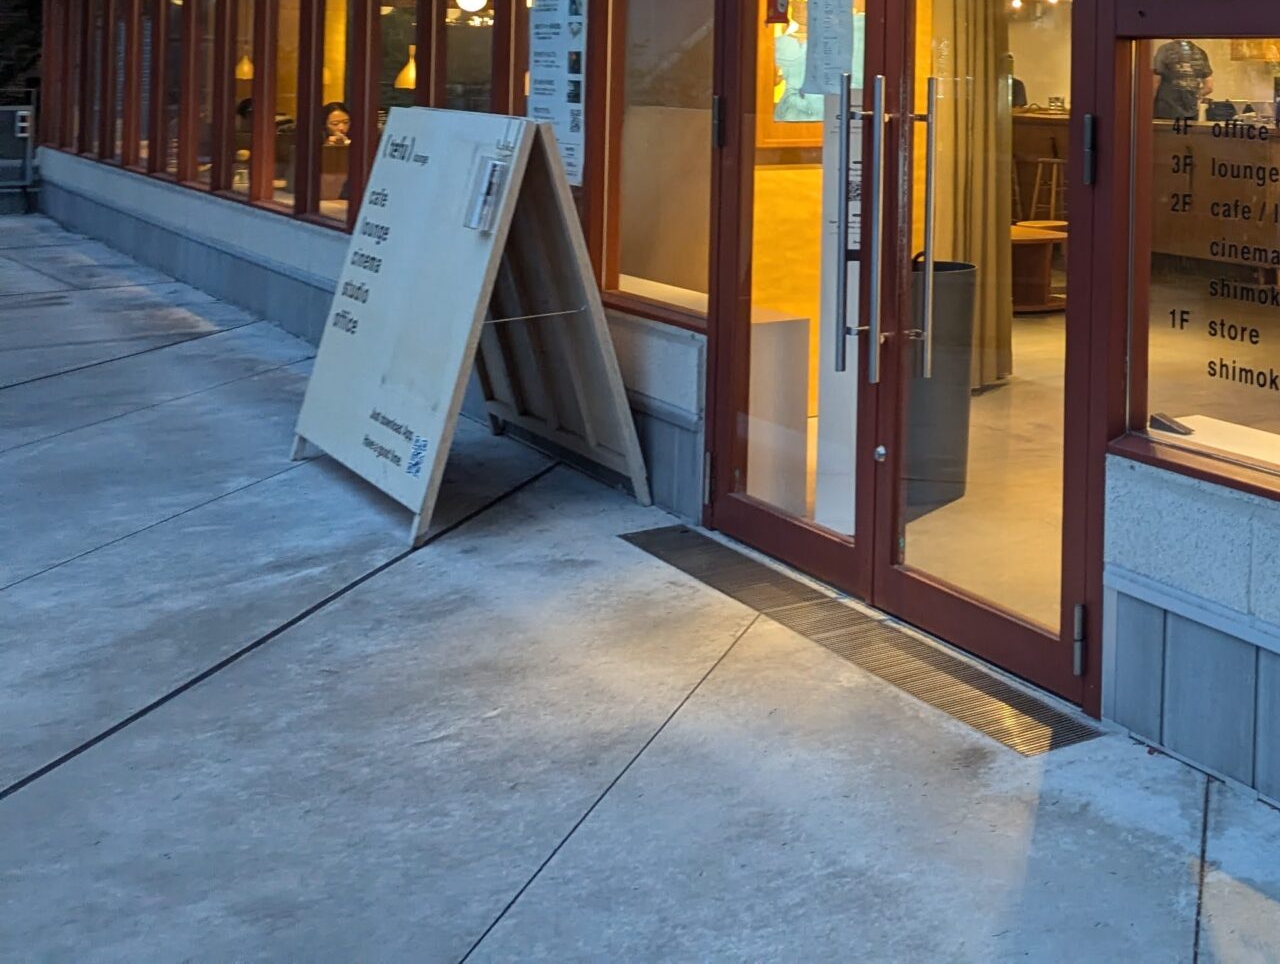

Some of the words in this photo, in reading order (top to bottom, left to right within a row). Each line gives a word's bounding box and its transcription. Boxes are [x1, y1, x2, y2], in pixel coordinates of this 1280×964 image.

[1172, 116, 1194, 135] 4F
[1212, 119, 1269, 141] office
[1171, 154, 1193, 175] 3F
[1211, 157, 1279, 187] lounge
[1171, 193, 1193, 213] 2F
[1211, 198, 1252, 221] cafe
[1210, 239, 1280, 266] cinema
[1169, 308, 1190, 330] 1F
[1208, 318, 1260, 345] store
